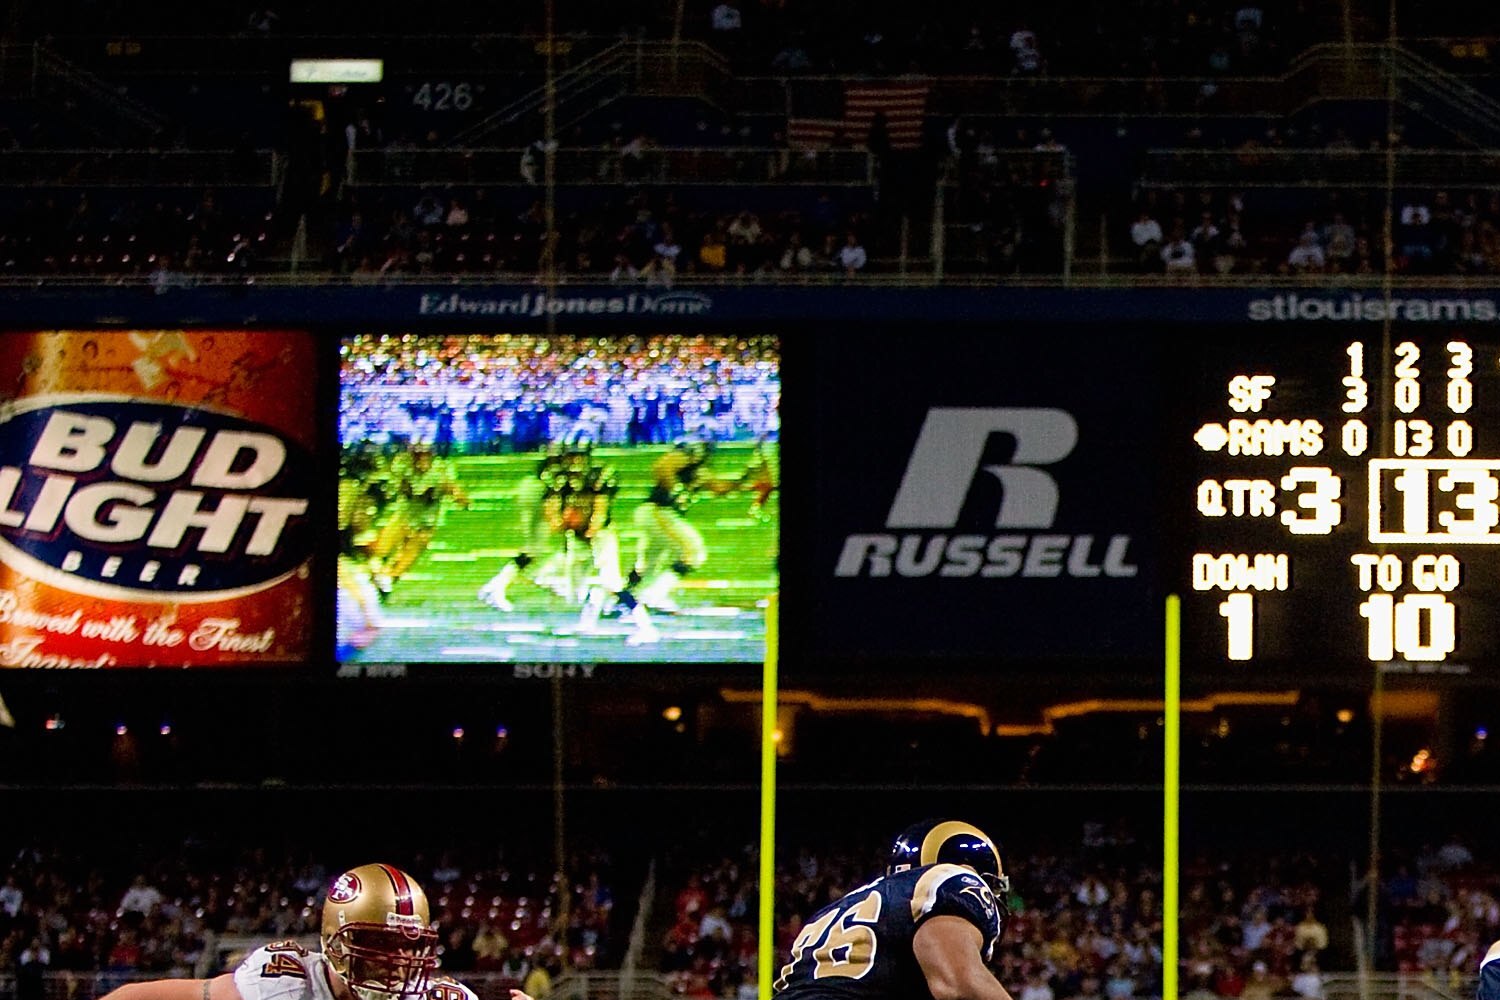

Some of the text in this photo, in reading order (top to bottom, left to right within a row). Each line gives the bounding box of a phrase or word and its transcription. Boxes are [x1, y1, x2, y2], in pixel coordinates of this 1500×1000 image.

[412, 82, 473, 111] 426
[1346, 341, 1363, 379] 1
[1395, 341, 1420, 379] 2
[1446, 341, 1472, 379] 3
[1228, 375, 1276, 412] SF
[1342, 376, 1368, 414] 3
[1394, 376, 1420, 414] 0
[1447, 376, 1472, 414] 0
[29, 410, 287, 490] BUD
[1228, 419, 1323, 456] RAMS
[1342, 420, 1367, 457] 0
[1394, 420, 1433, 457] 13
[1447, 420, 1472, 457] 0
[0, 465, 309, 556] LIGHT
[1197, 467, 1341, 535] QTR 3
[61, 550, 201, 586] BEER
[834, 533, 1139, 578] RUSSELL
[1192, 553, 1289, 591] DOWN
[1351, 554, 1460, 592] TO GO
[81, 614, 140, 643] with
[142, 620, 186, 648] the
[188, 617, 277, 654] Finest
[1219, 593, 1253, 661] 1
[1360, 593, 1455, 661] 10
